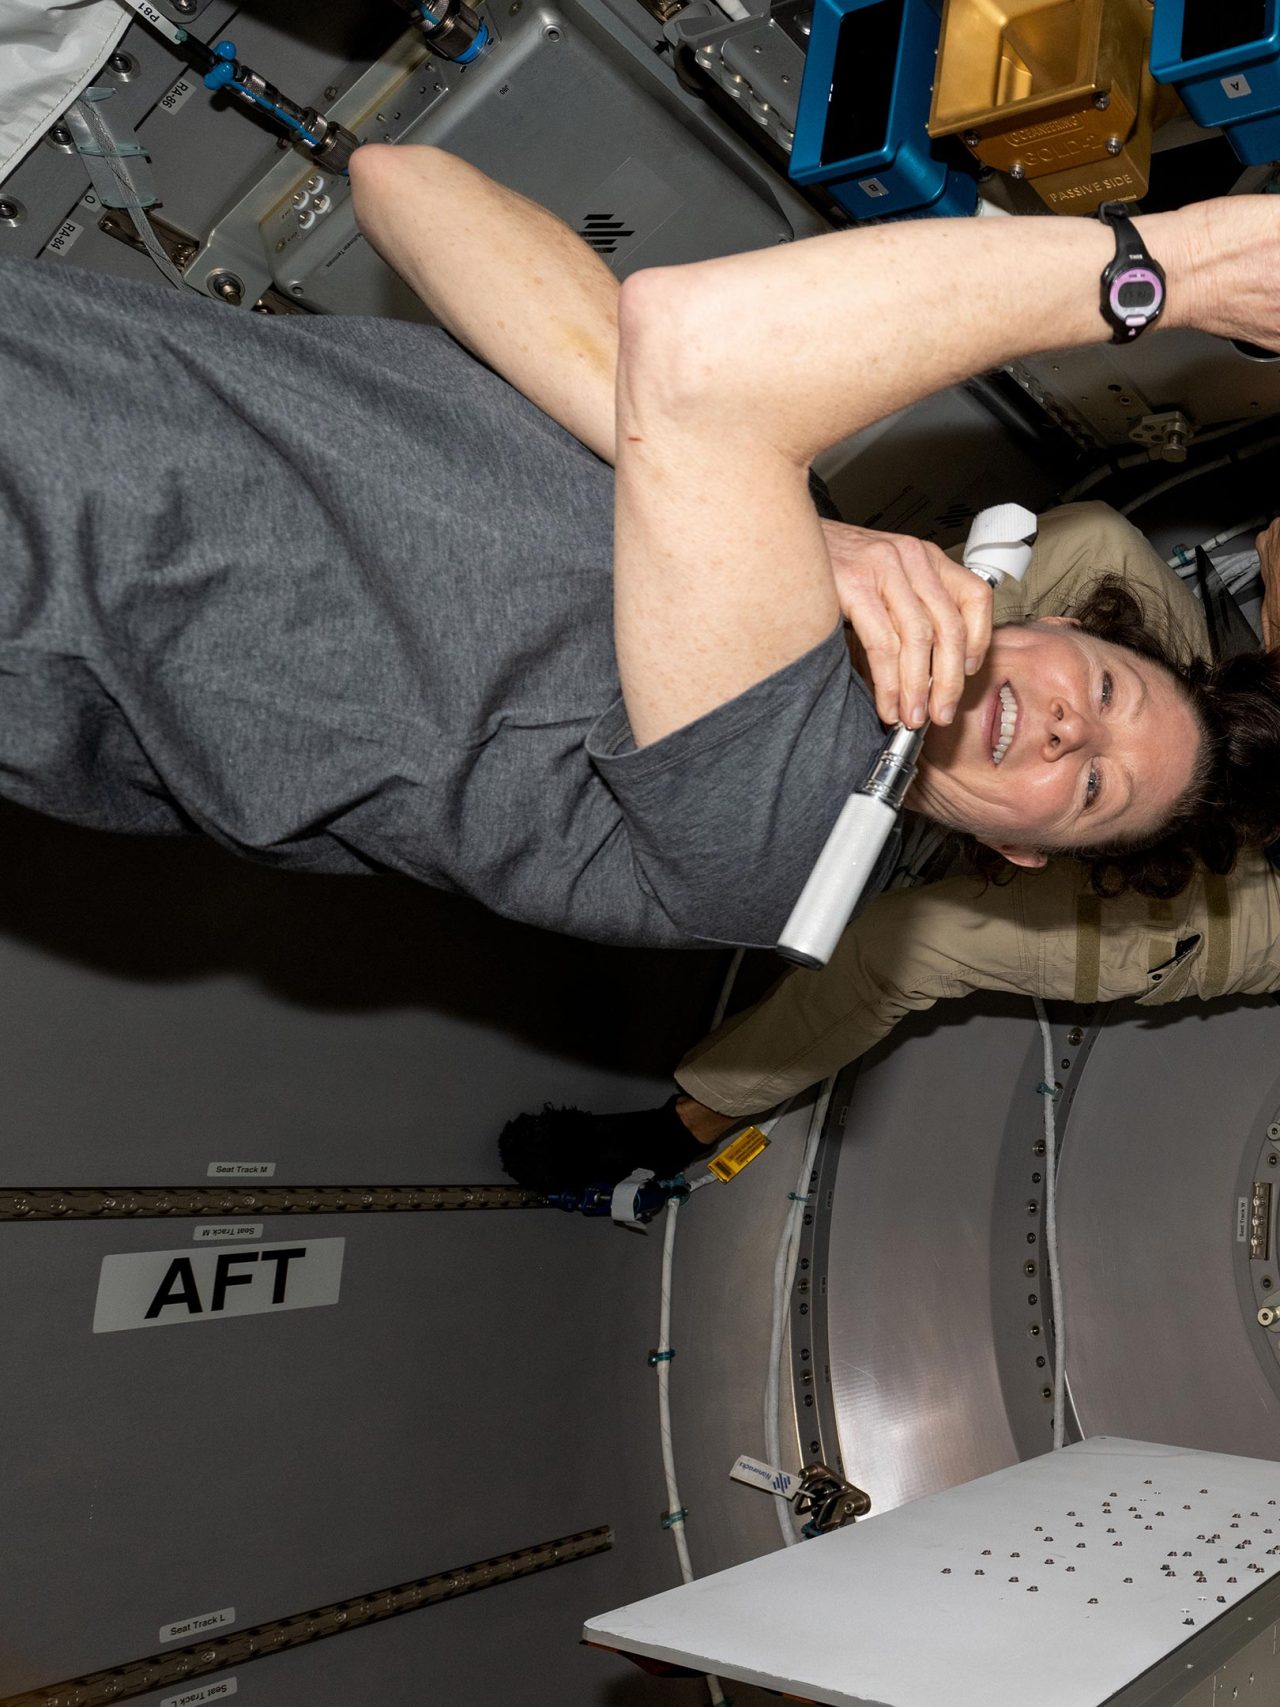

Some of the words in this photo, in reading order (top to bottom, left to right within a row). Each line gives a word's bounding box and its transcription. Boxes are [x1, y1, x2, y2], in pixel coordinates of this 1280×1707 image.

[138, 3, 159, 23] P81
[162, 81, 188, 108] RA-86
[1230, 81, 1240, 91] A
[1012, 115, 1078, 142] OCEANEERING
[1049, 181, 1103, 202] PASSIVE
[1105, 174, 1133, 190] SIDE
[51, 222, 76, 250] RA-84
[216, 1165, 235, 1174] Seat
[236, 1165, 259, 1174] Track
[259, 1165, 268, 1174] M
[213, 1228, 235, 1236] Track
[239, 1227, 255, 1235] Seat
[144, 1247, 306, 1320] AFT
[738, 1460, 773, 1481] Nanoracks
[170, 1625, 191, 1636] Seat
[193, 1618, 218, 1631] Track
[219, 1613, 226, 1623] L
[181, 1691, 206, 1705] Track
[207, 1684, 228, 1697] Seat
